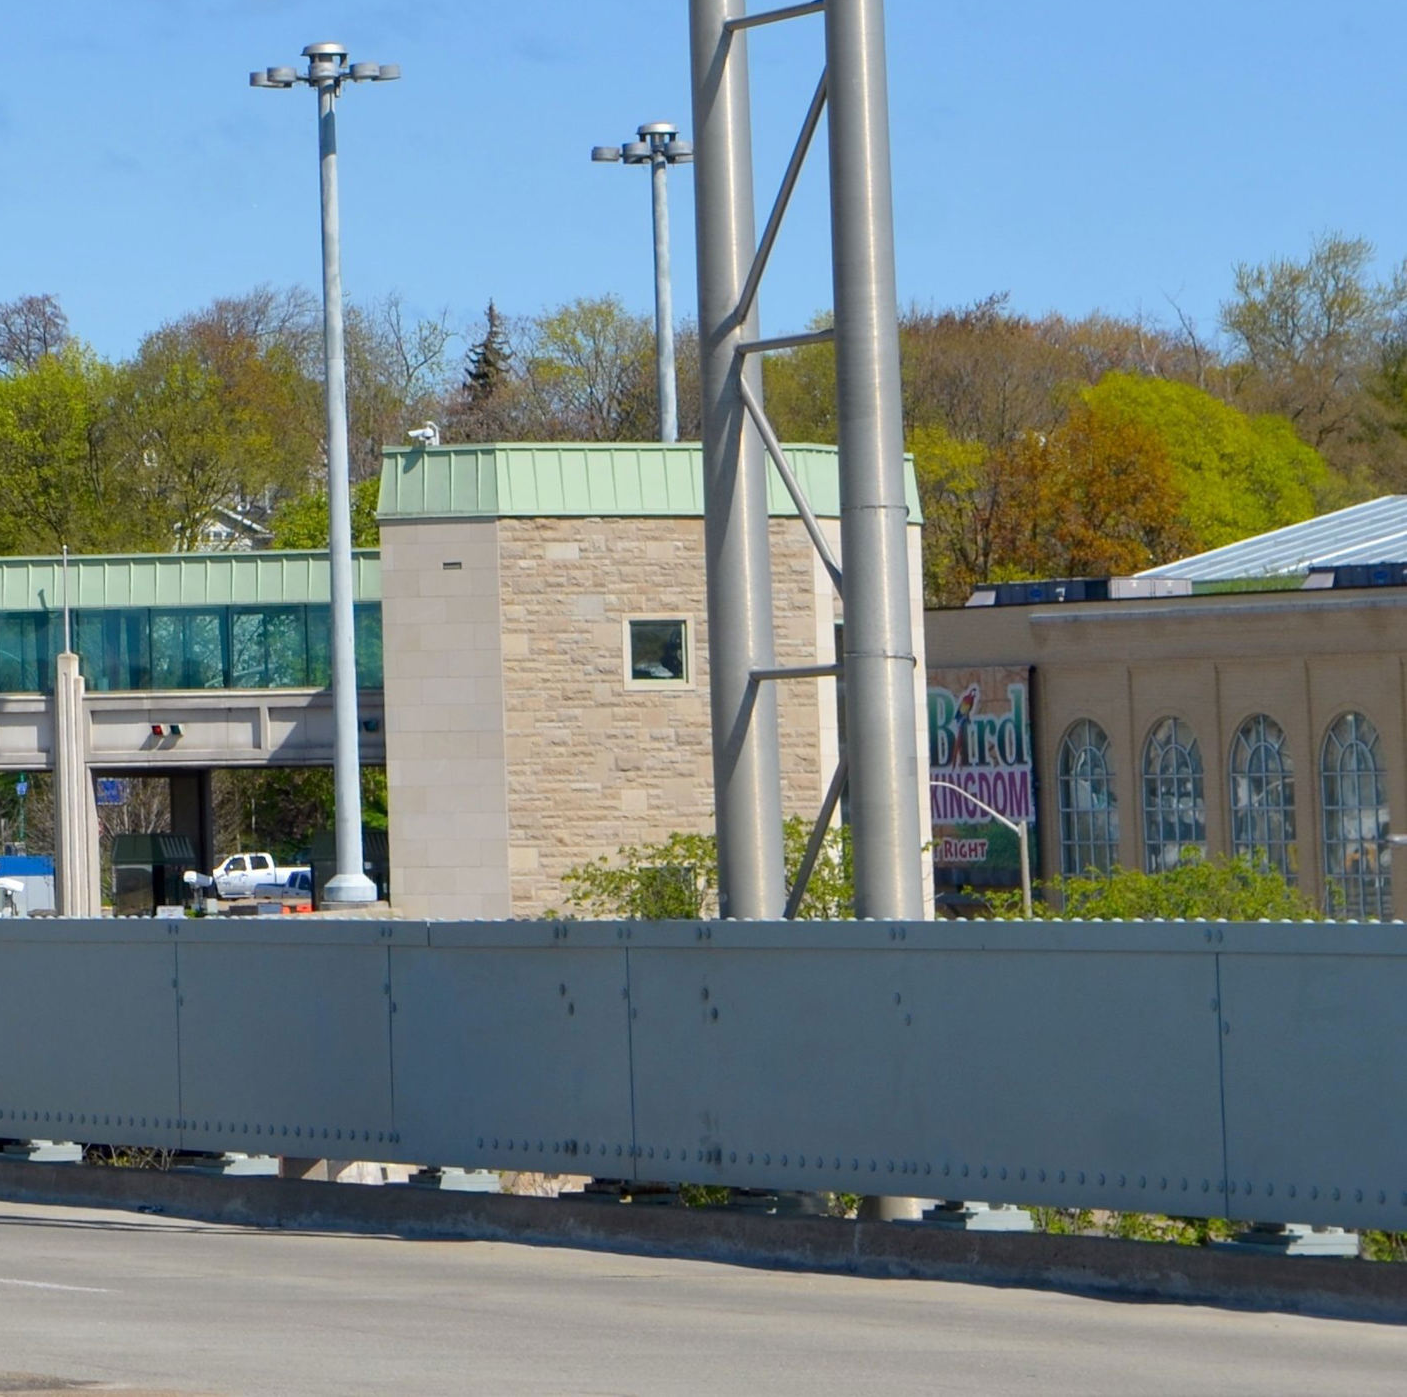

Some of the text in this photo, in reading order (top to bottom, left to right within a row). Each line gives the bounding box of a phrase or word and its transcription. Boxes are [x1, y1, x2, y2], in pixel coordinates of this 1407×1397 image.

[928, 686, 1027, 767] Bird
[930, 770, 1030, 819] KINGDOM
[944, 840, 987, 859] RIGHT
